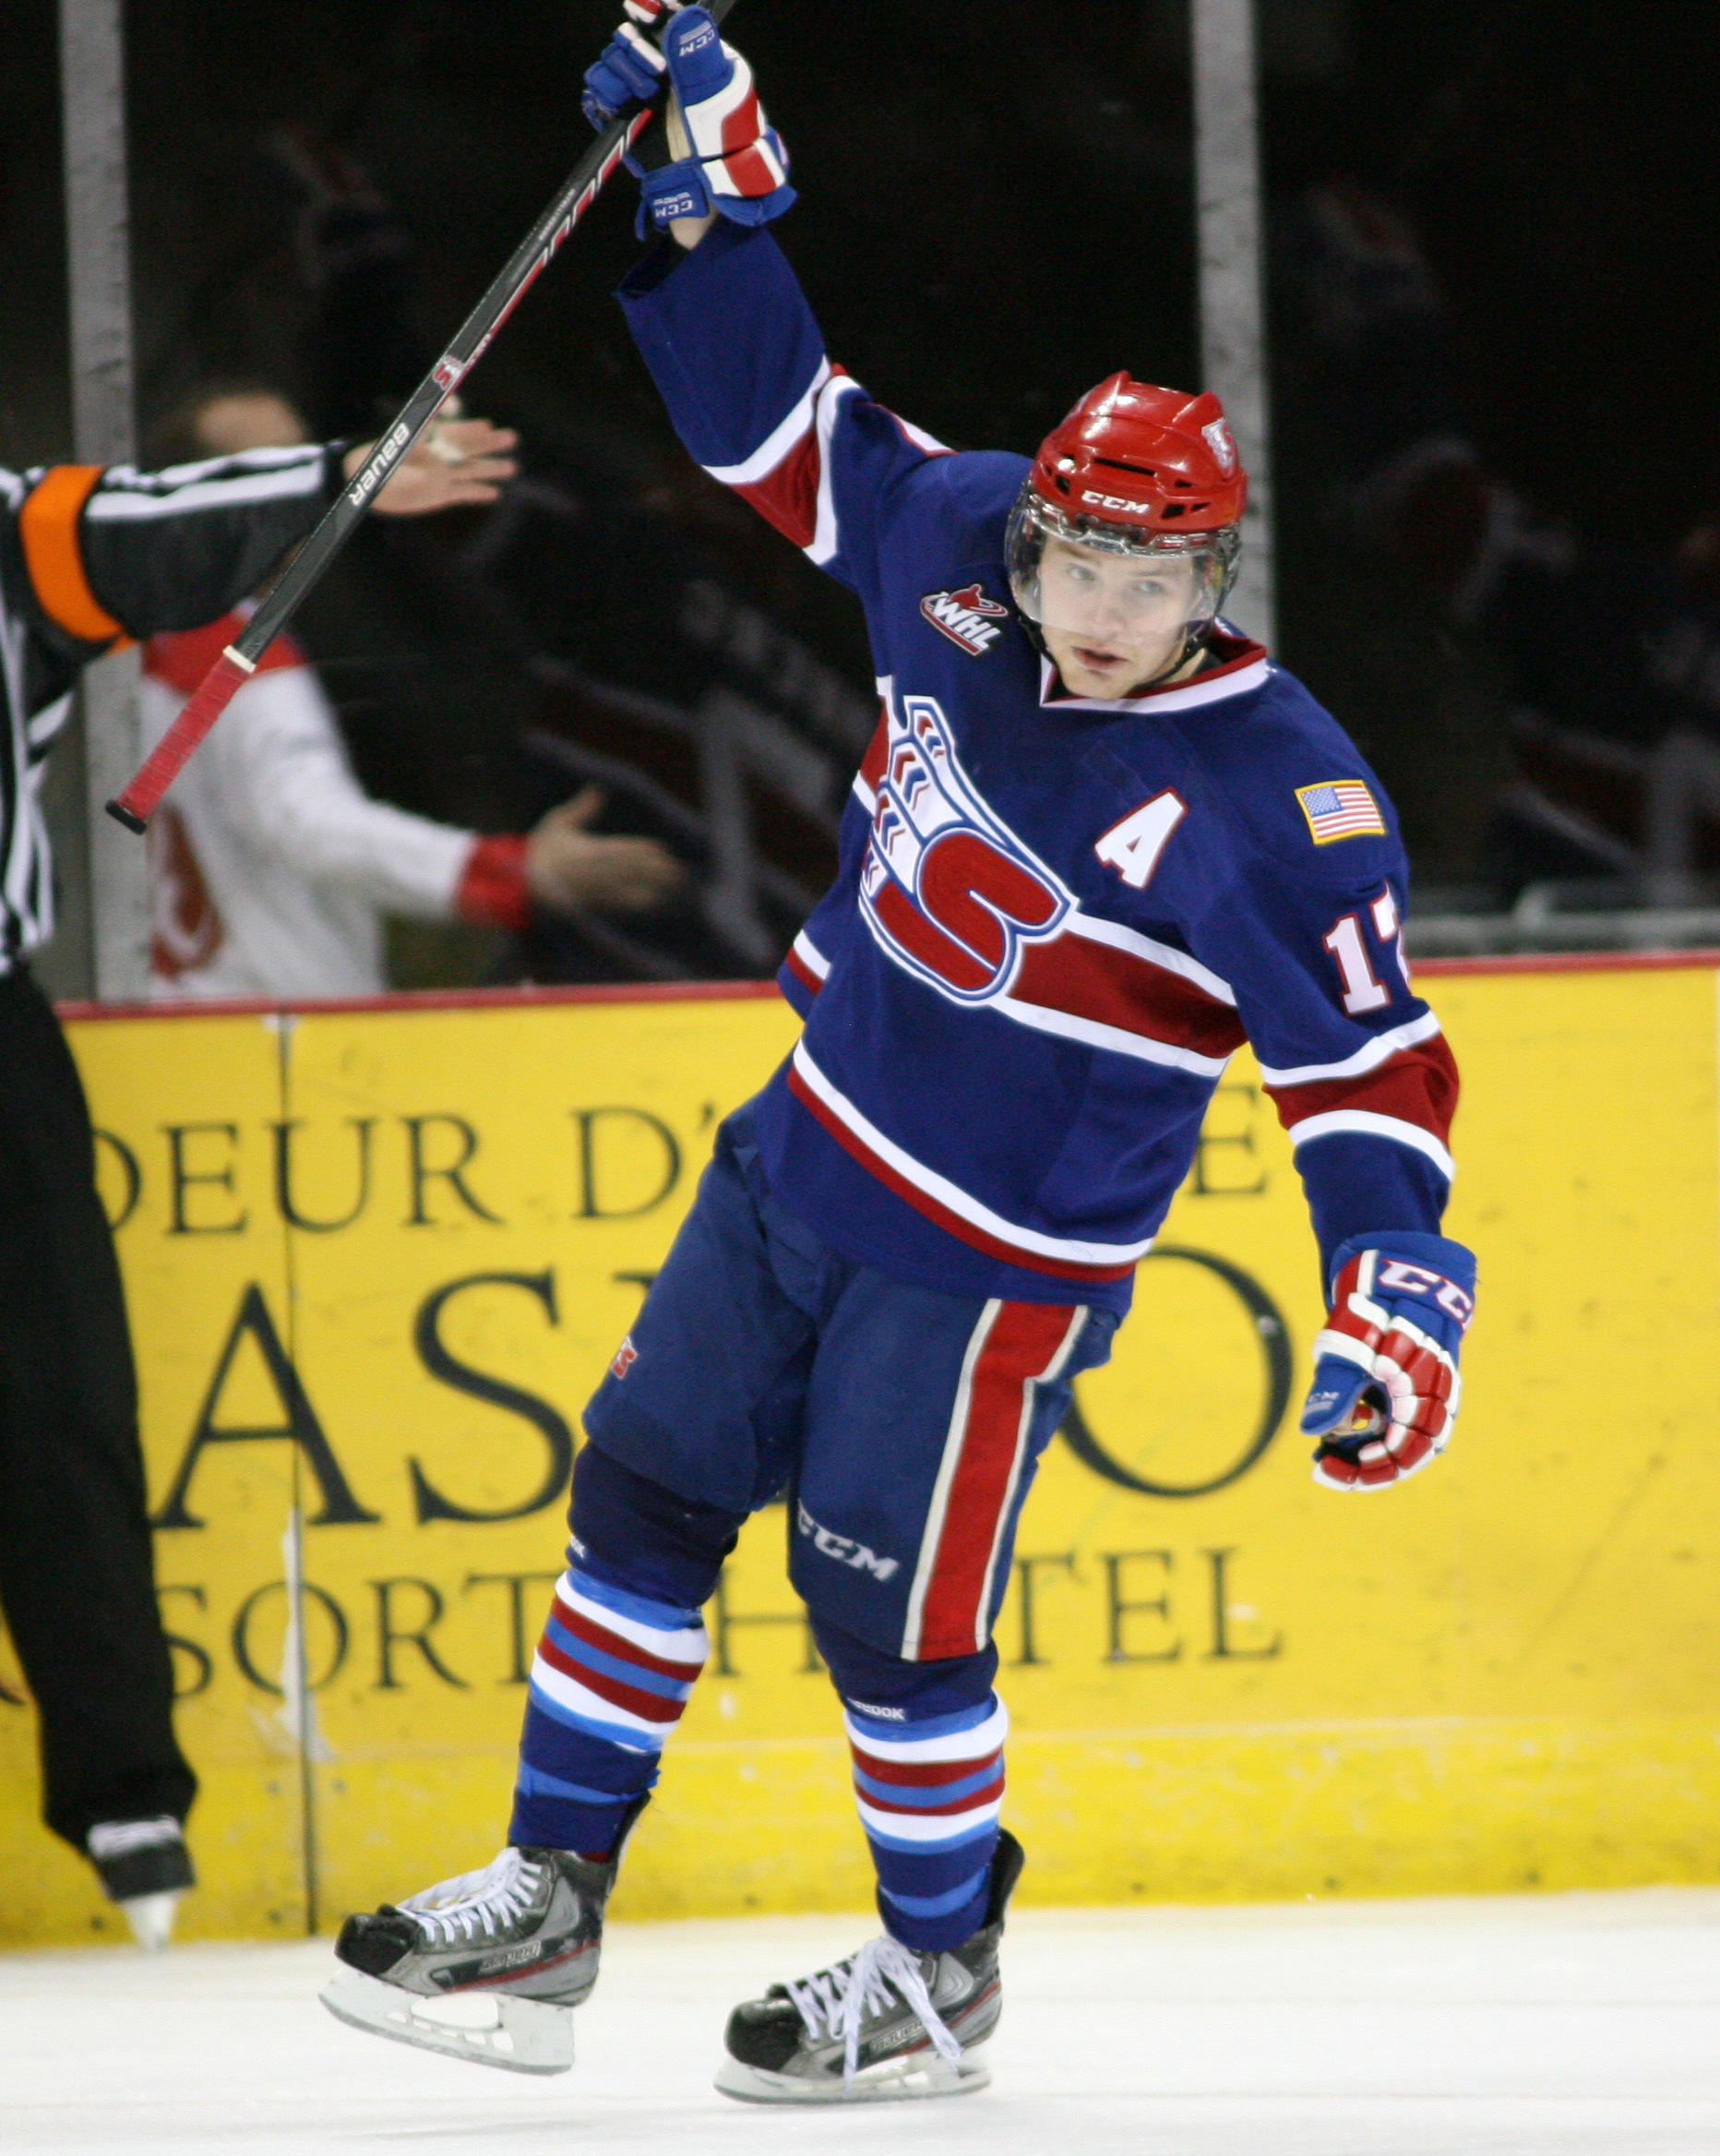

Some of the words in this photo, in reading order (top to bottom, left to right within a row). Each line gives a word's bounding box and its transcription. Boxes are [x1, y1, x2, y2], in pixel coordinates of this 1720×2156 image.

[679, 30, 715, 56] CCM
[655, 199, 693, 218] CCM
[1081, 488, 1151, 514] CCM
[932, 592, 1002, 653] WHL
[1094, 786, 1189, 890] A
[1378, 1258, 1474, 1330] CC
[798, 1498, 900, 1581] CCM
